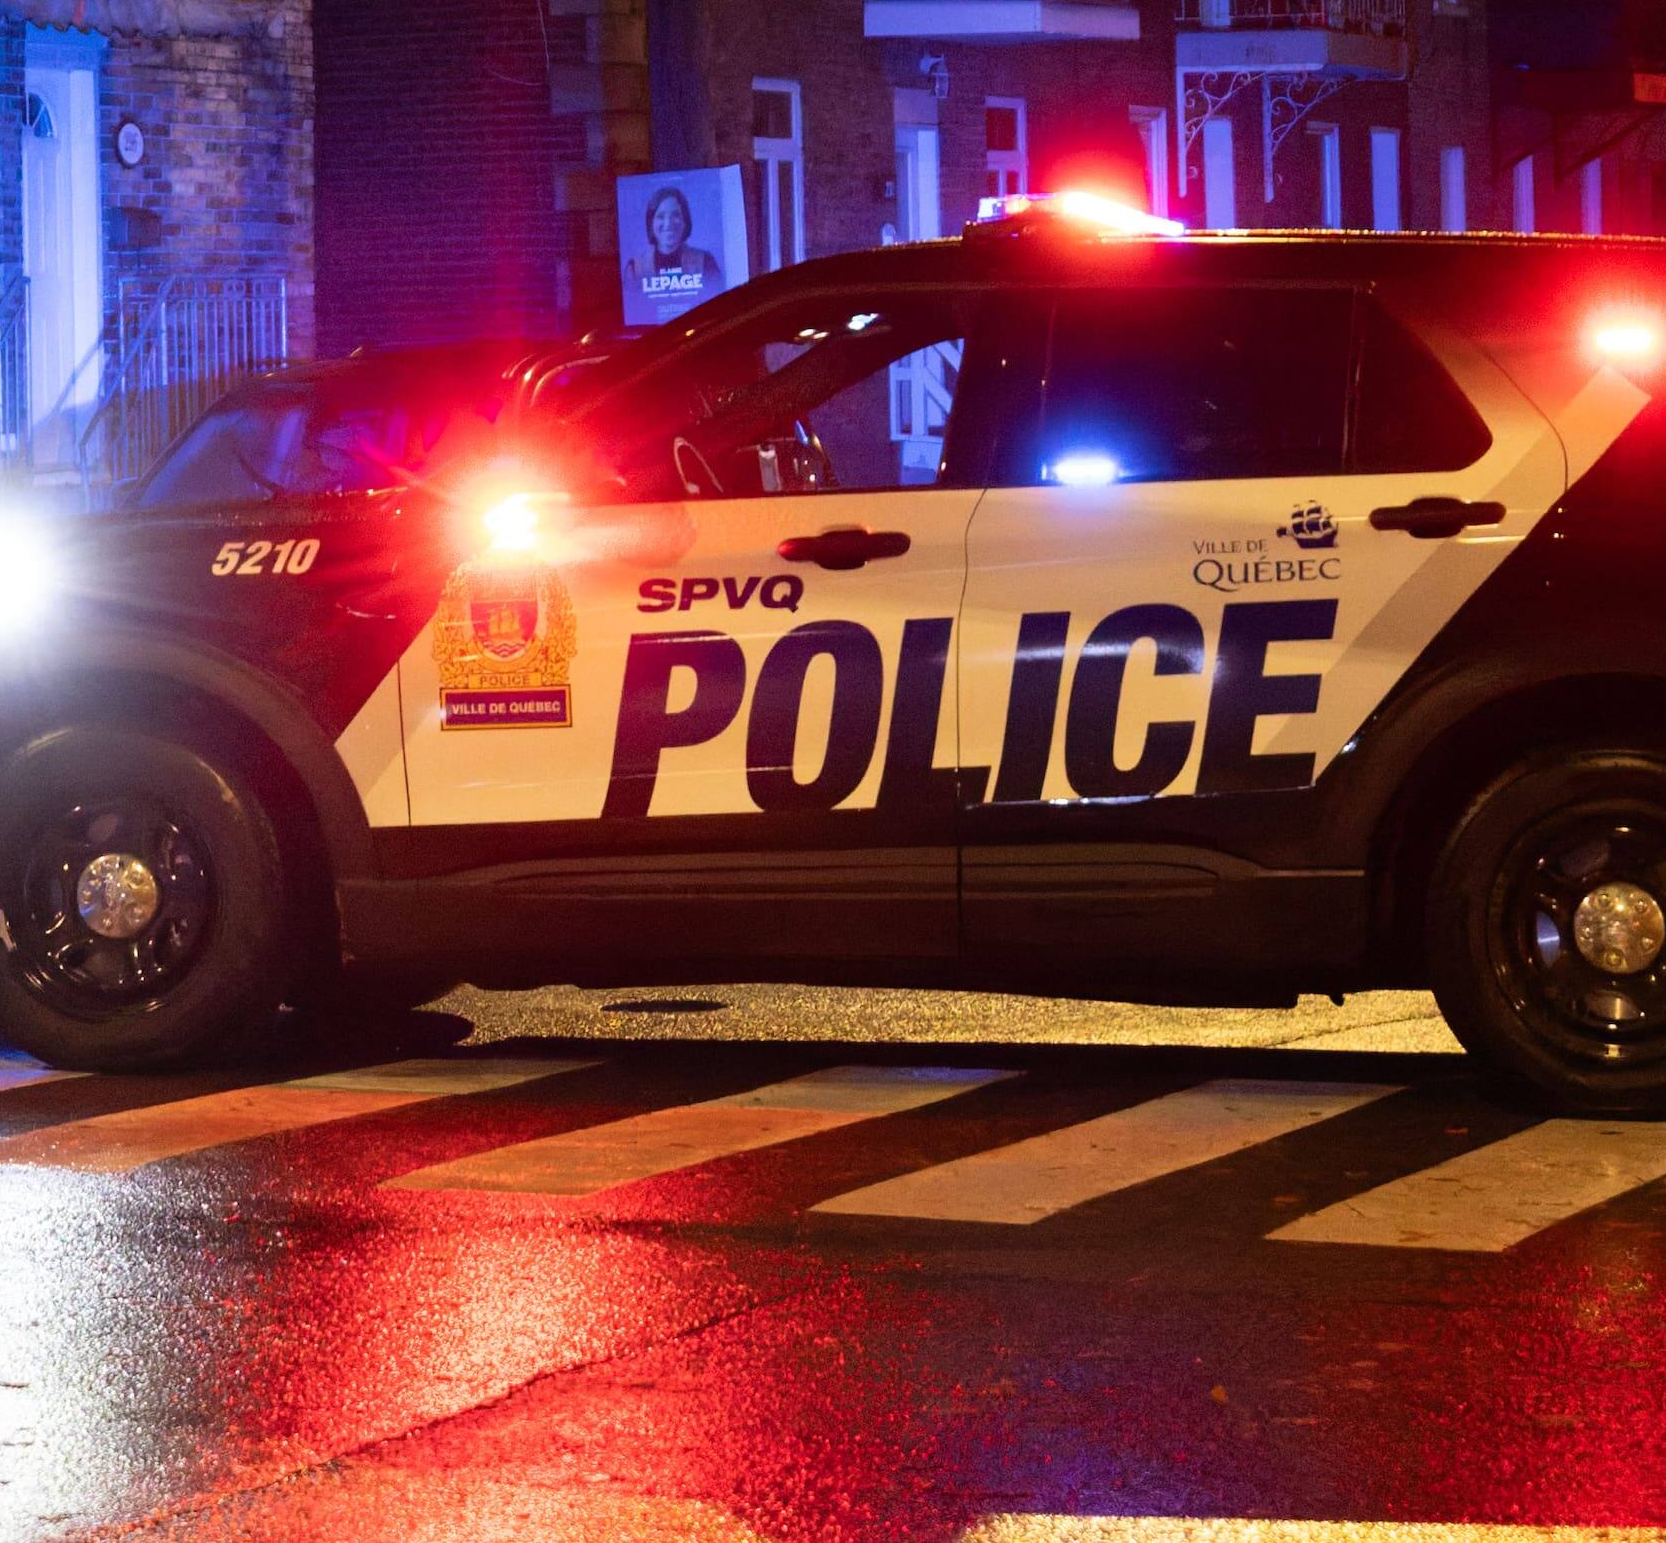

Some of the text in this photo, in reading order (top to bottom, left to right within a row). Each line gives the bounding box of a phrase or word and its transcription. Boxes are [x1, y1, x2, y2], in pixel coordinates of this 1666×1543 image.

[642, 273, 703, 293] LEPAGE
[212, 539, 320, 575] 5210
[1192, 539, 1268, 554] VILLE DE
[1193, 556, 1341, 592] QUÉBEC
[637, 574, 804, 613] SPVQ
[479, 674, 531, 685] POLICE
[452, 703, 485, 715] VILLE
[489, 702, 506, 714] DE
[601, 598, 1339, 817] POLICE
